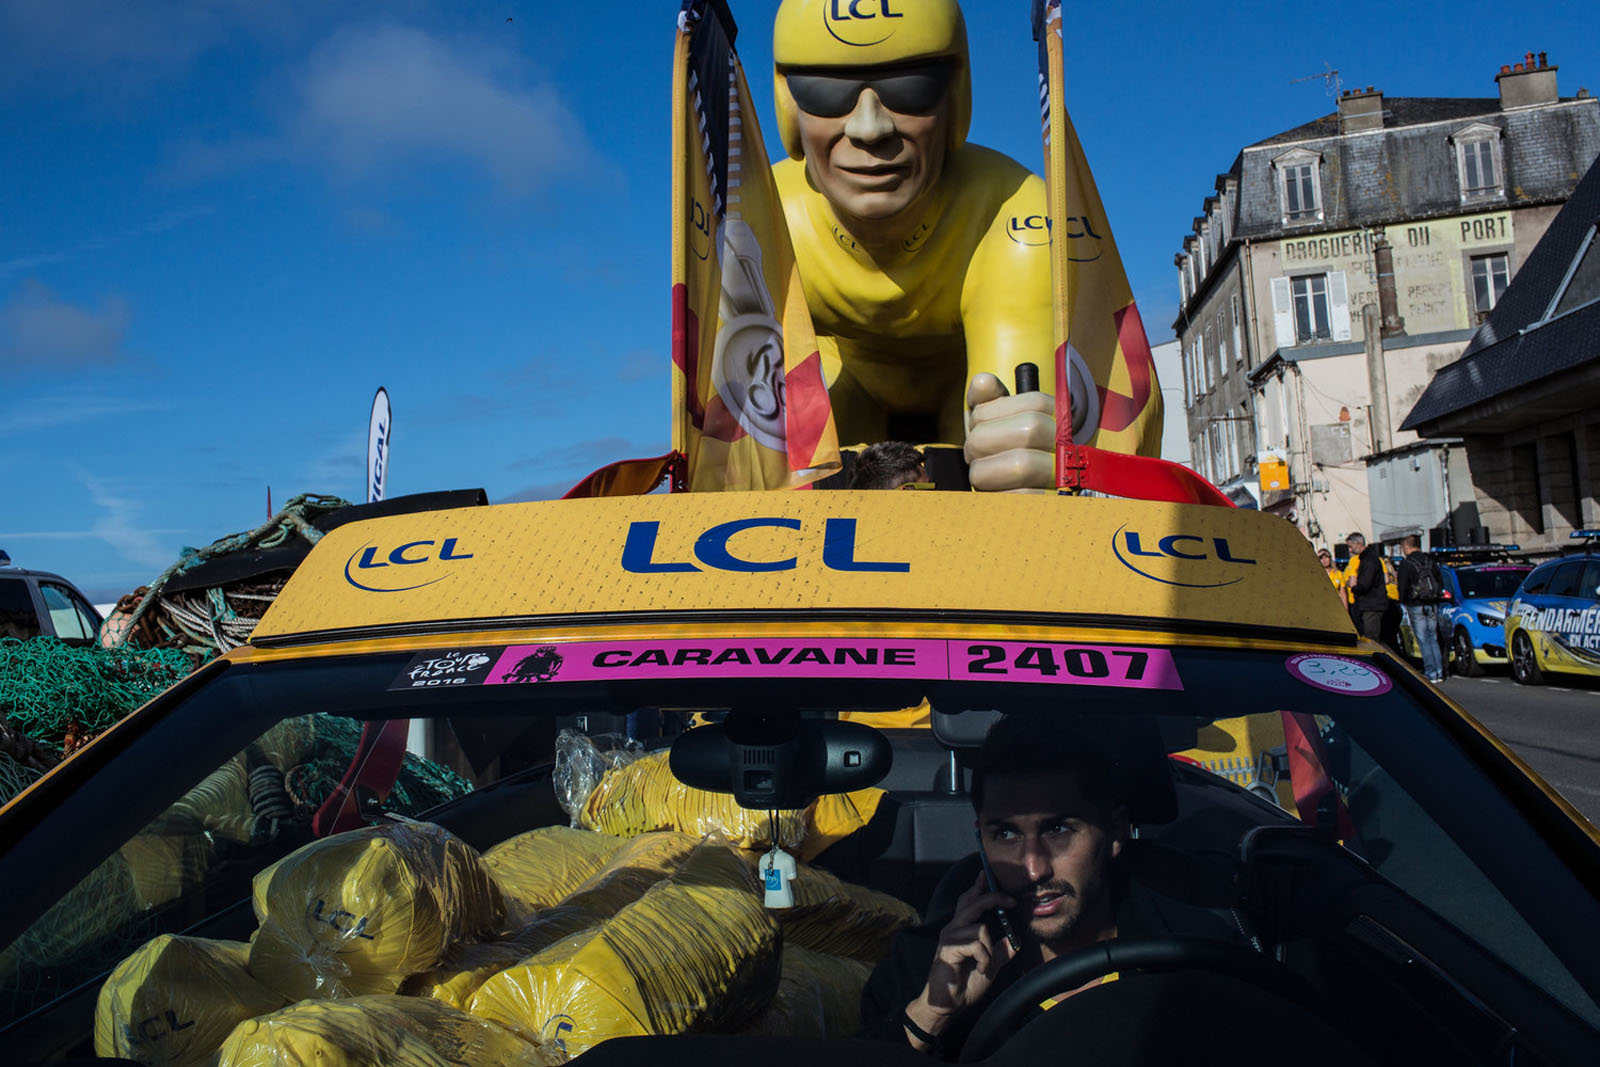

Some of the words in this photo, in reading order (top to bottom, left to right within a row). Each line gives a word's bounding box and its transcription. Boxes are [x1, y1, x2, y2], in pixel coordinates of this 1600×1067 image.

[831, 0, 904, 21] LCL
[1461, 216, 1506, 242] PORT
[358, 538, 474, 569] LCL
[621, 517, 911, 574] LCL
[1124, 531, 1257, 565] LCL
[592, 647, 916, 668] CARAVANE
[967, 645, 1149, 681] 2407
[411, 677, 466, 687] 2016
